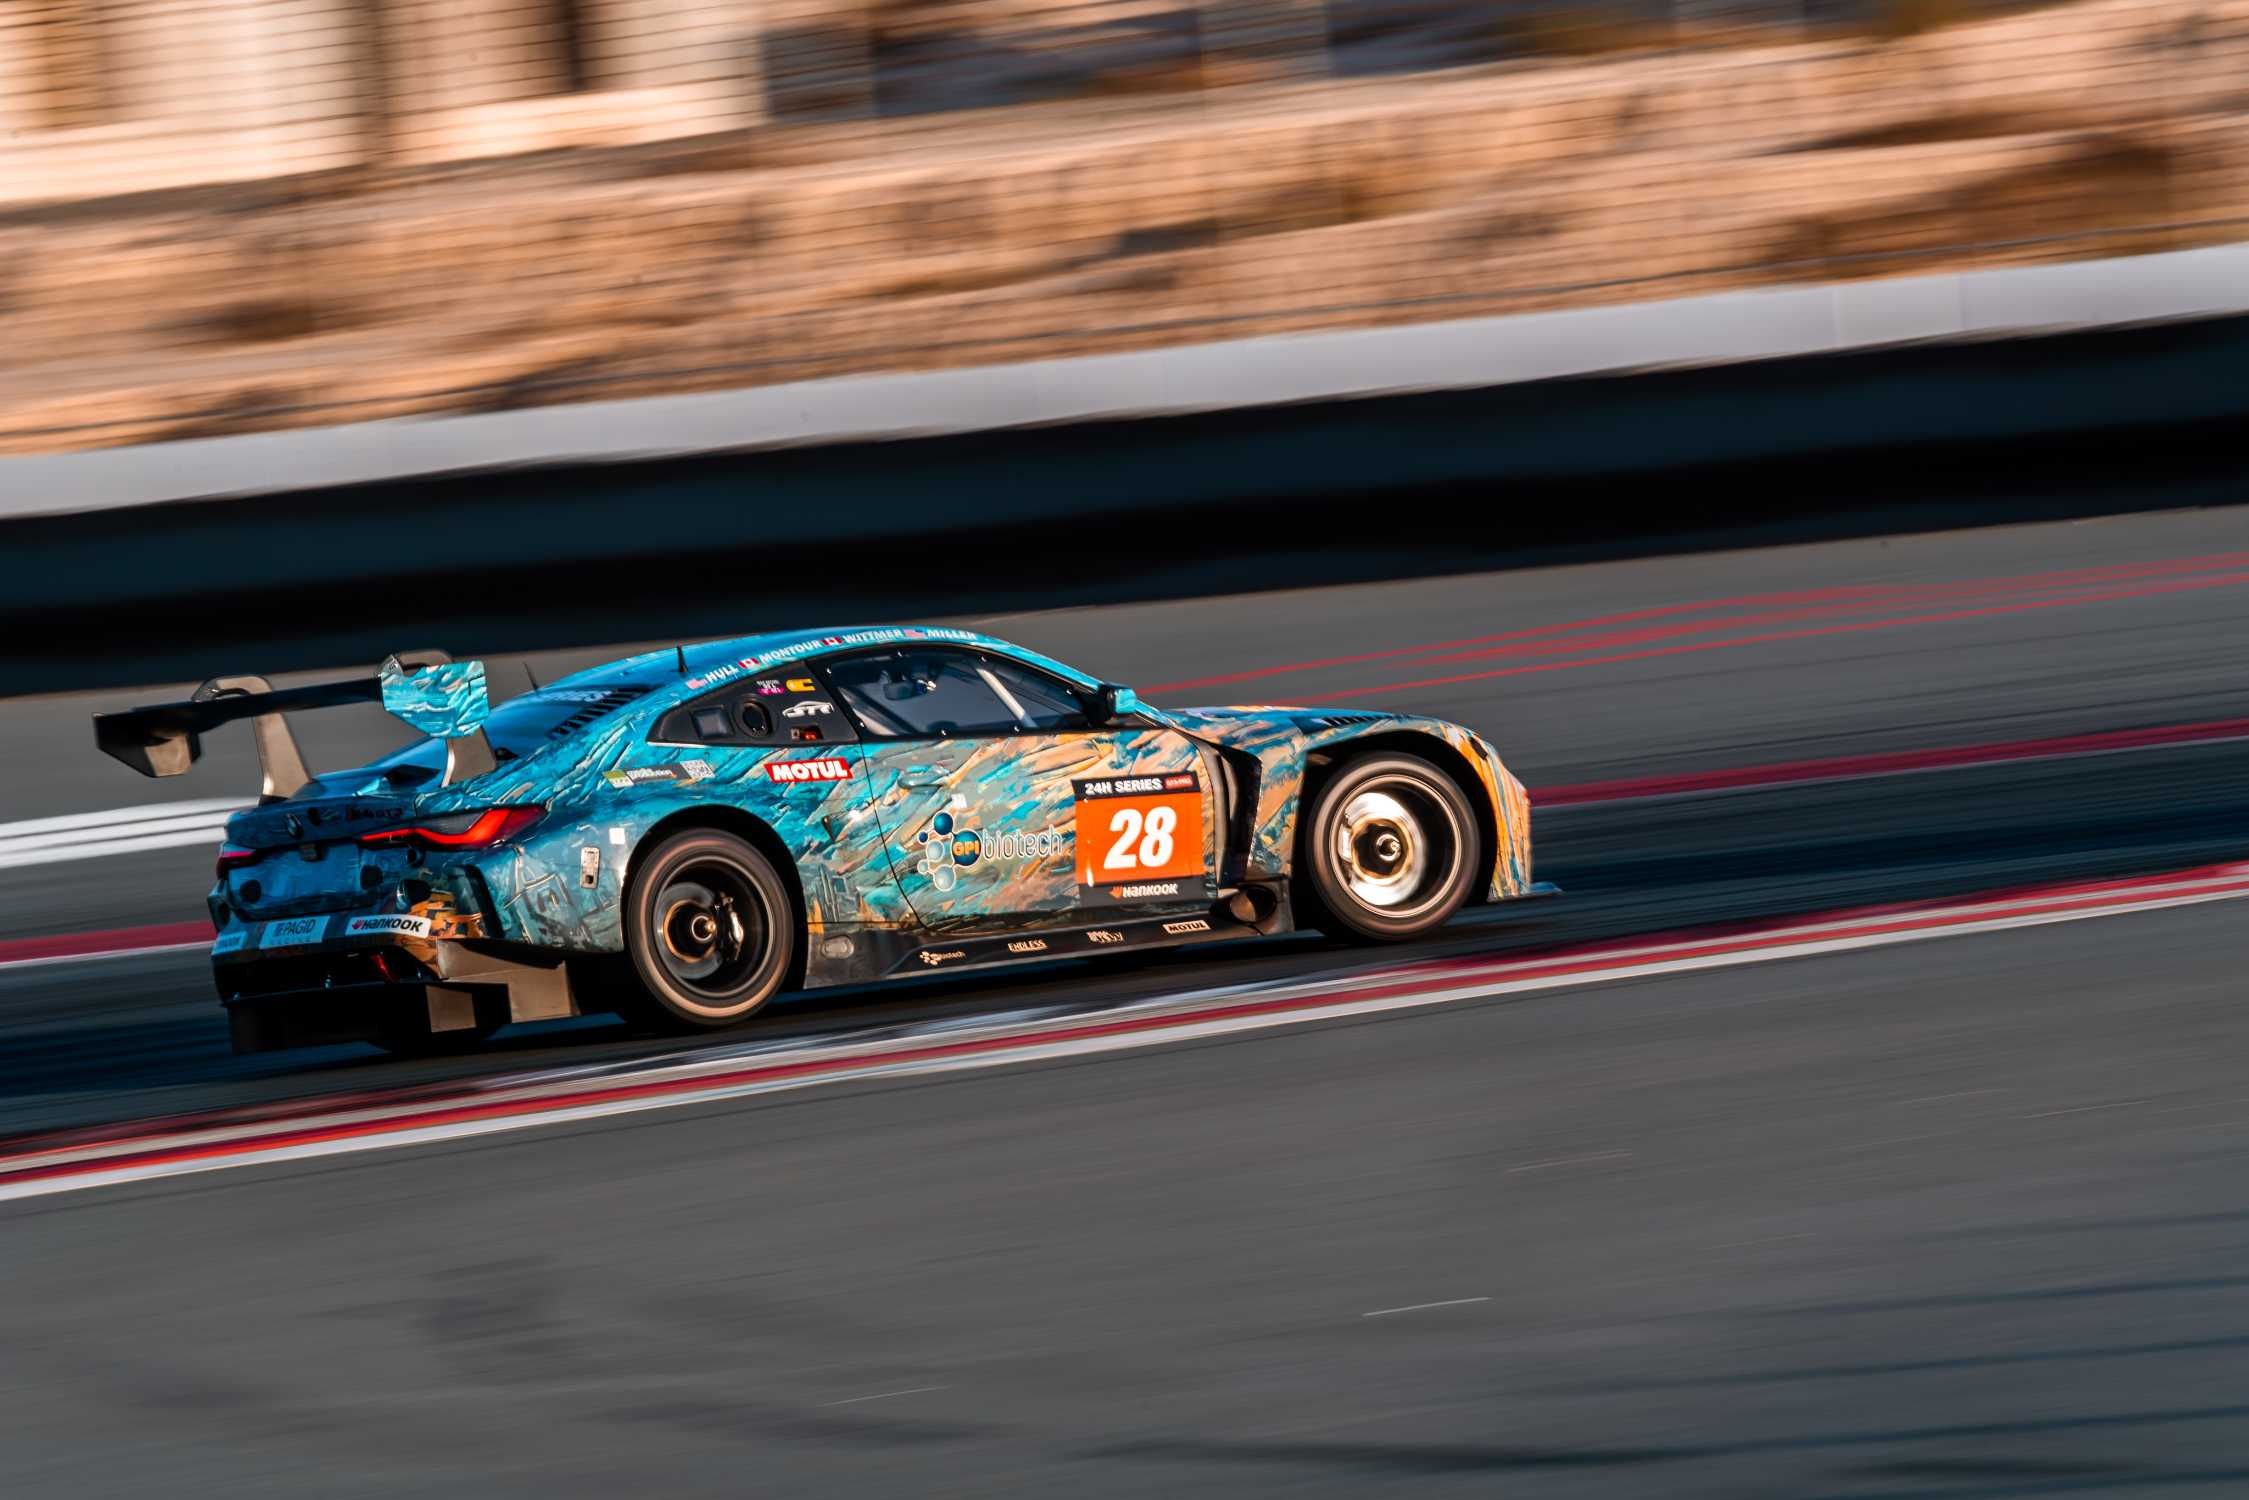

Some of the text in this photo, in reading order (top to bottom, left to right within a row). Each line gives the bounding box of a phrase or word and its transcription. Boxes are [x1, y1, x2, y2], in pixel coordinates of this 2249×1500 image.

[705, 664, 738, 682] HULL
[759, 640, 821, 664] MONTOUR
[772, 761, 848, 780] MOTUL
[1085, 778, 1163, 795] 24H SERIES
[981, 824, 1064, 860] biotech
[1103, 806, 1177, 870] 28
[953, 840, 979, 857] GPI
[283, 919, 316, 936] PAGID
[1168, 921, 1206, 933] MOTUL
[1008, 939, 1048, 952] ENDLESS
